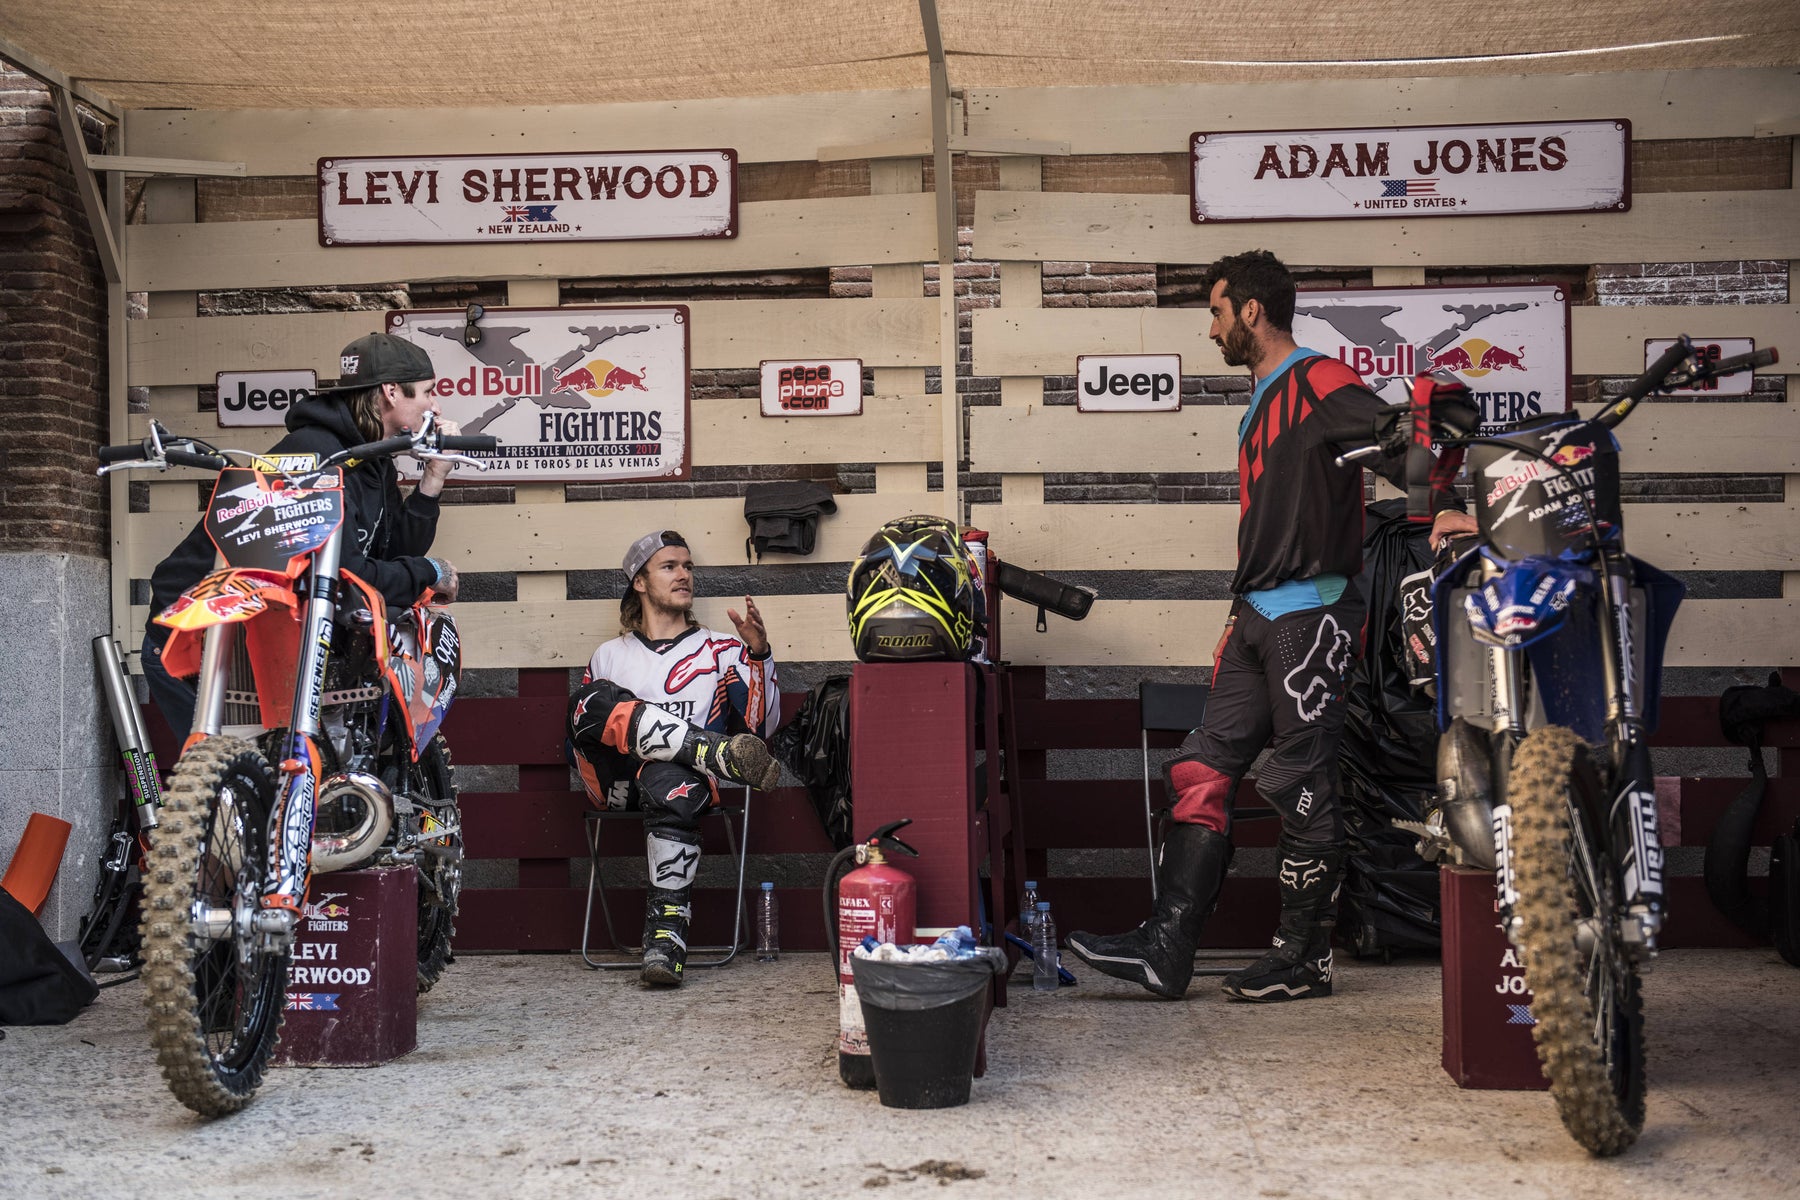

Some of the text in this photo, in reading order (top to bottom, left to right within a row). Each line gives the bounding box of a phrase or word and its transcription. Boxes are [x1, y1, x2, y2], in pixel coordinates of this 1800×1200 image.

[1253, 136, 1569, 180] ADAM JONES
[337, 163, 719, 205] LEVI SHERWOOD
[1364, 198, 1456, 209] UNITED STATES
[488, 223, 570, 234] NEW ZEALAND
[1353, 344, 1414, 376] Bull
[431, 365, 541, 396] ed Bull
[780, 367, 829, 385] pepe
[1084, 366, 1174, 401] Jeep
[781, 379, 843, 400] phone
[783, 396, 827, 408] .com
[539, 411, 662, 442] FIGHTERS
[506, 445, 560, 457] FREESTYLE
[565, 444, 630, 456] MOTOCROSS
[635, 443, 659, 454] 2017
[516, 459, 529, 469] DE
[535, 459, 571, 469] TOROS
[576, 458, 589, 468] DE
[594, 458, 613, 468] LAS
[619, 457, 660, 467] VENTAS
[1503, 462, 1539, 491] Bull
[216, 492, 273, 523] Red Bull
[274, 497, 333, 522] FIGHTERS
[1528, 500, 1563, 522] ADAM
[236, 515, 325, 545] LEVI SHERWOOD
[877, 633, 934, 648] ADAM
[133, 752, 151, 799] SUSPENSION
[1296, 786, 1314, 816] FOX
[308, 920, 349, 932] FIGHTERS
[290, 943, 338, 961] LEVI
[286, 967, 371, 985] ERWOOD
